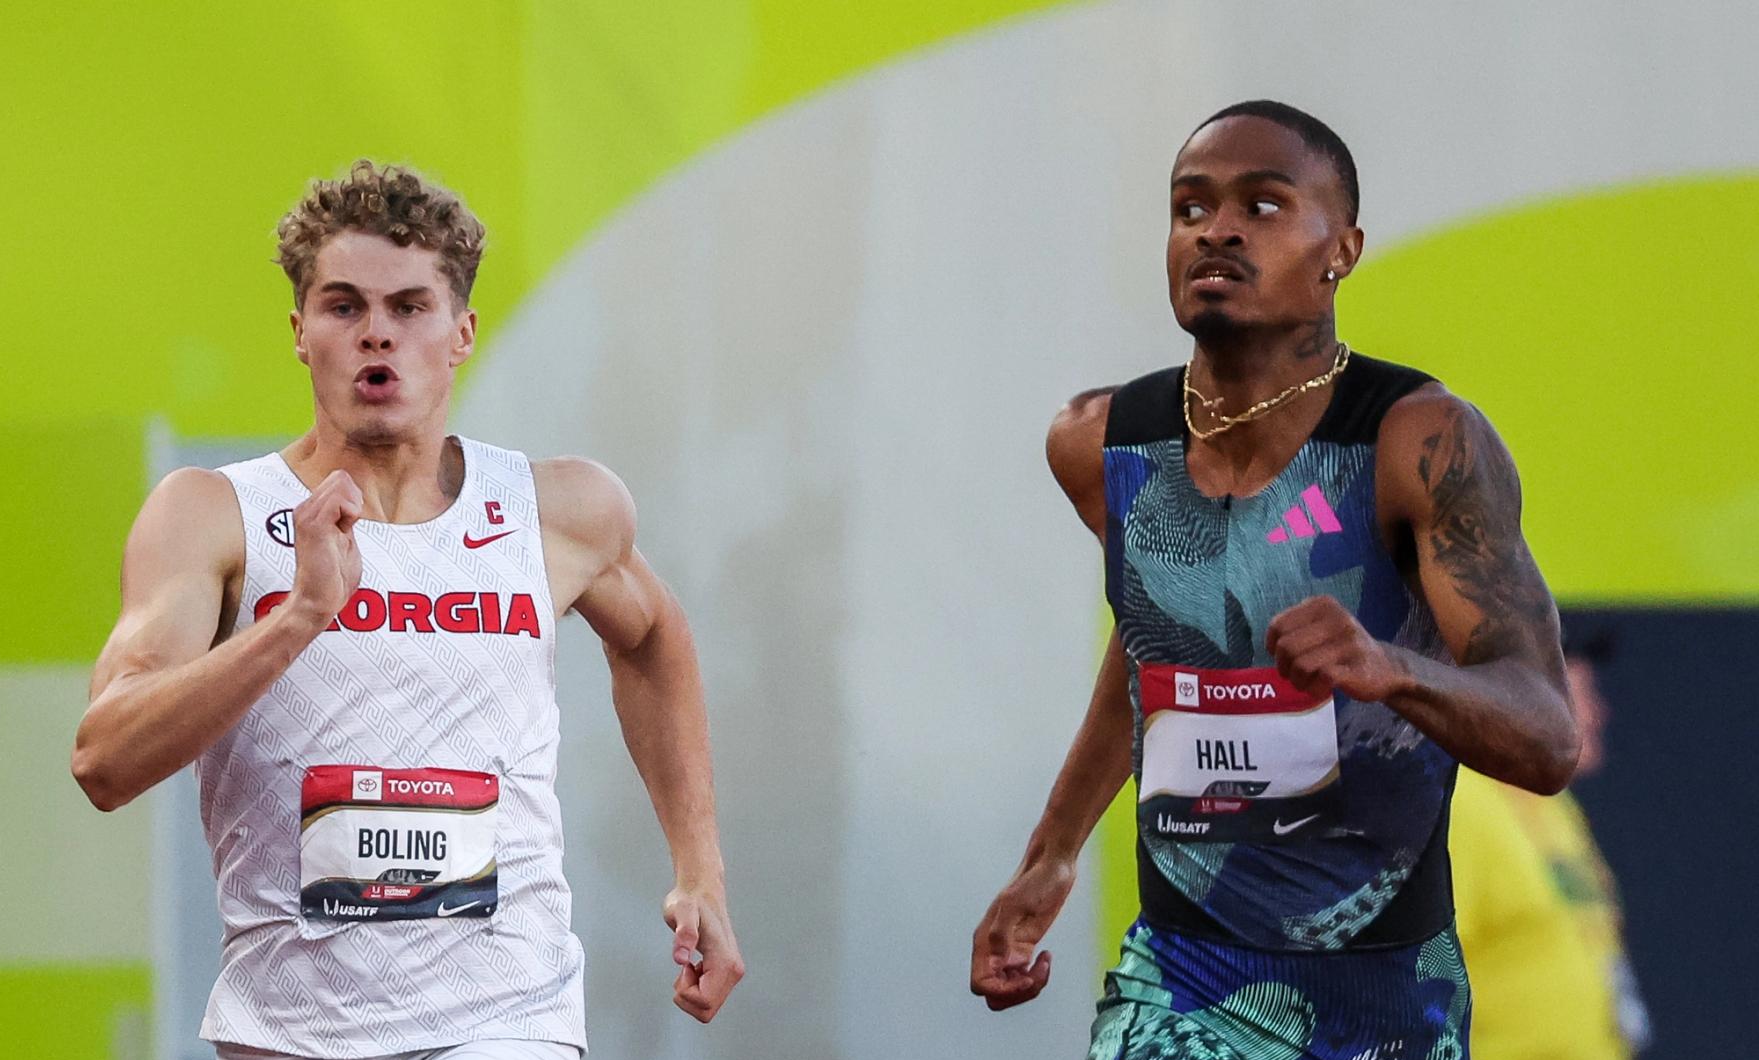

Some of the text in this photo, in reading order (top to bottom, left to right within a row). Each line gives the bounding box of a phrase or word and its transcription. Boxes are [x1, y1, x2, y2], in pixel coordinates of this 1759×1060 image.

[484, 501, 505, 525] C
[254, 588, 541, 639] ORGIA
[1204, 683, 1276, 700] TOYOTA
[1195, 738, 1258, 771] HALL
[387, 779, 455, 796] TOYOTA
[1170, 821, 1211, 835] USATF
[357, 828, 448, 862] BOLING
[339, 905, 379, 917] USATF
